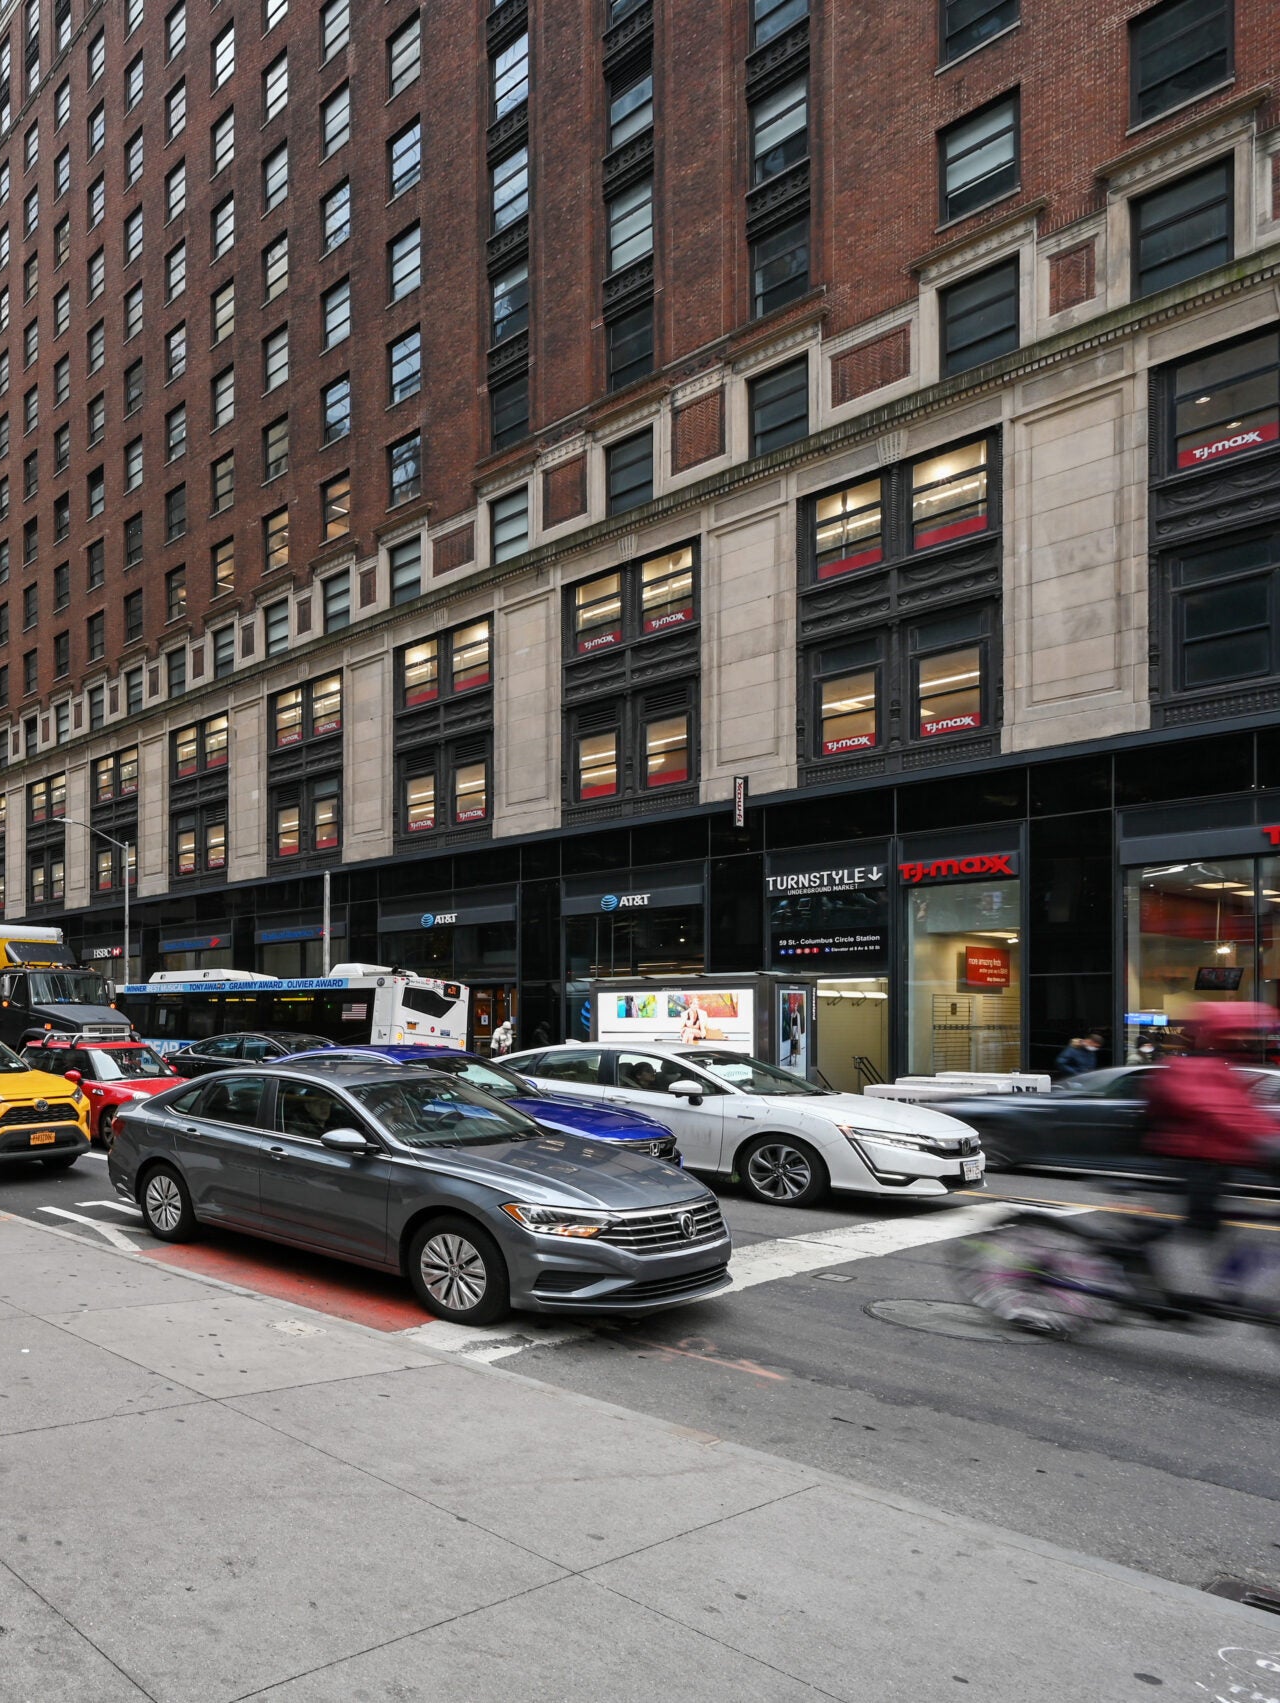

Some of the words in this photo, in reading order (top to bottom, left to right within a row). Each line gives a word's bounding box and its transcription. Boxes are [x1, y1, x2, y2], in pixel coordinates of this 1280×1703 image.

[765, 867, 866, 891] TURNSTYLE
[787, 887, 832, 896] UNDERGROUND
[833, 883, 859, 892] MARKET
[619, 894, 651, 907] AT&T
[434, 913, 458, 925] AT&T
[800, 937, 833, 945] Columbus
[93, 948, 111, 958] HSBC
[189, 983, 204, 991] TONY
[229, 982, 257, 990] GRAMMY
[258, 980, 283, 989] AWARD
[287, 980, 314, 989] OLIVIER
[315, 979, 343, 988] AWARD
